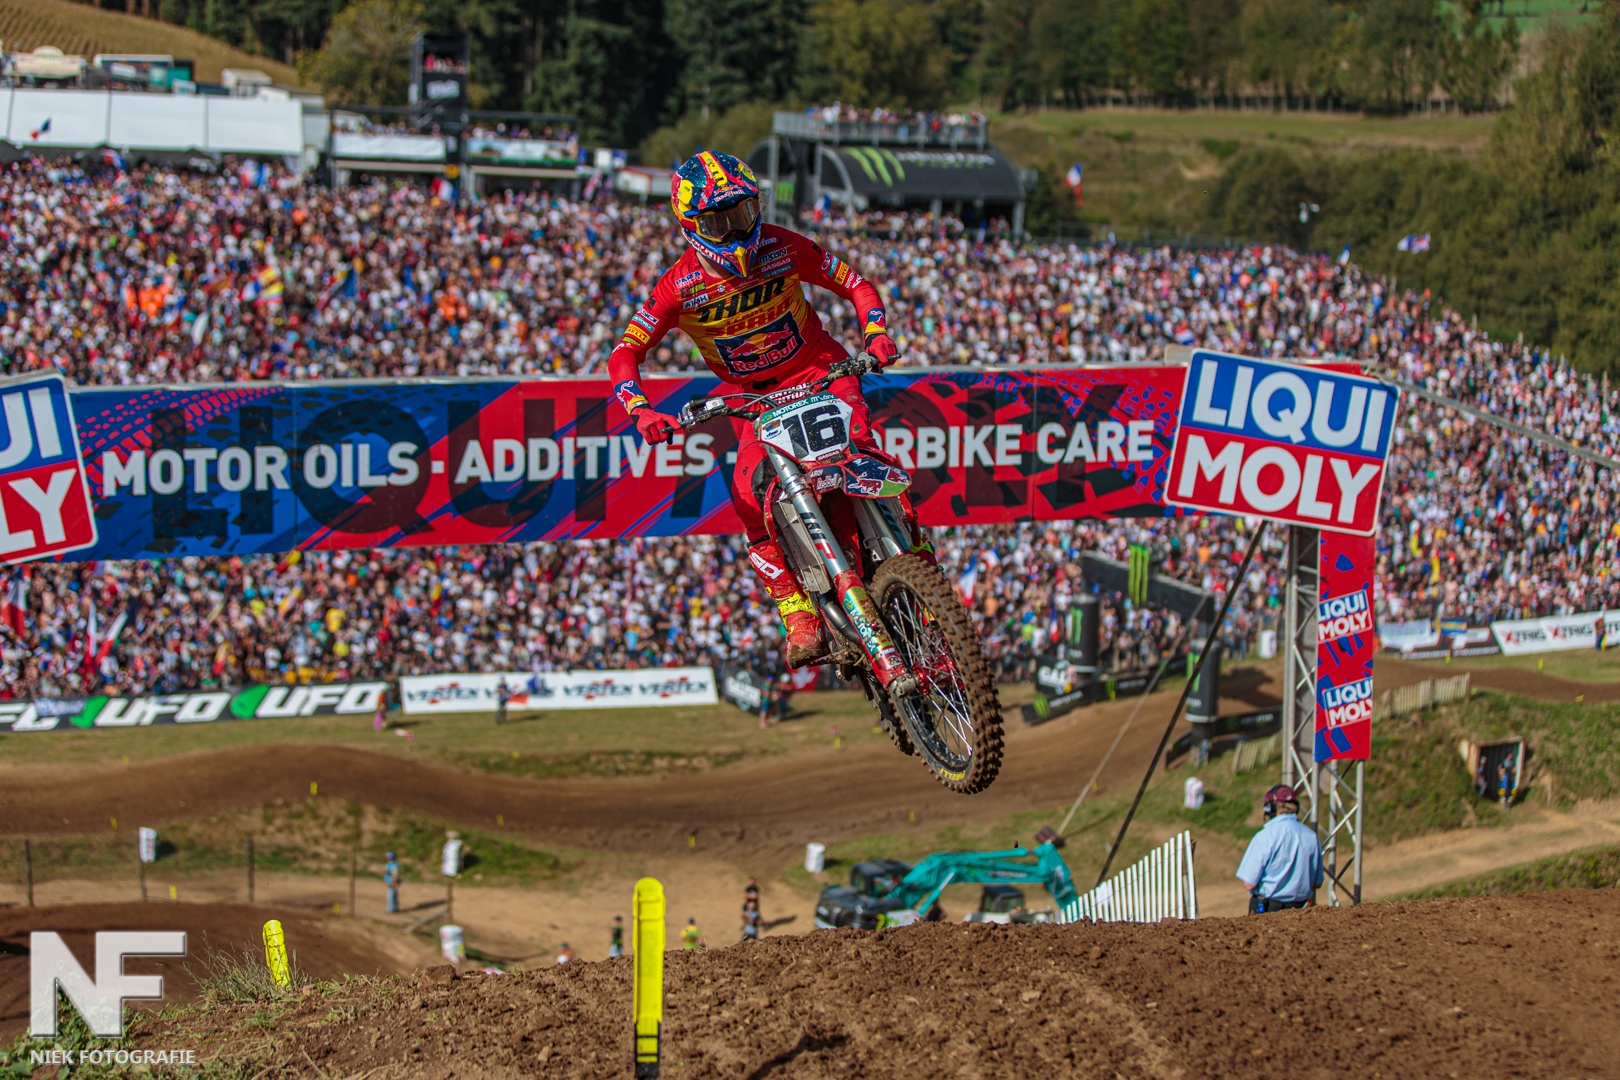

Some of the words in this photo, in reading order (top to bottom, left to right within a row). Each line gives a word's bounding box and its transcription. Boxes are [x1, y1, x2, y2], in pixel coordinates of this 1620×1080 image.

[695, 276, 785, 322] THOR
[731, 354, 769, 372] Red
[766, 336, 798, 364] Bull
[772, 398, 810, 418] MOTOREX
[1192, 359, 1387, 452] LIQUI
[782, 405, 847, 459] 16
[101, 445, 290, 497] MOTOR
[303, 441, 420, 489] OILS
[454, 432, 715, 484] ADDITIVES
[1036, 420, 1155, 464] CARE
[1178, 434, 1381, 524] MOLY
[1318, 592, 1366, 621] LIQUI
[1318, 610, 1368, 641] MOLY
[94, 692, 231, 727] UFO
[255, 681, 388, 718] UFO
[563, 683, 633, 697] VERTEX
[639, 680, 708, 696] VERTEX
[940, 768, 966, 781] PIRELLI
